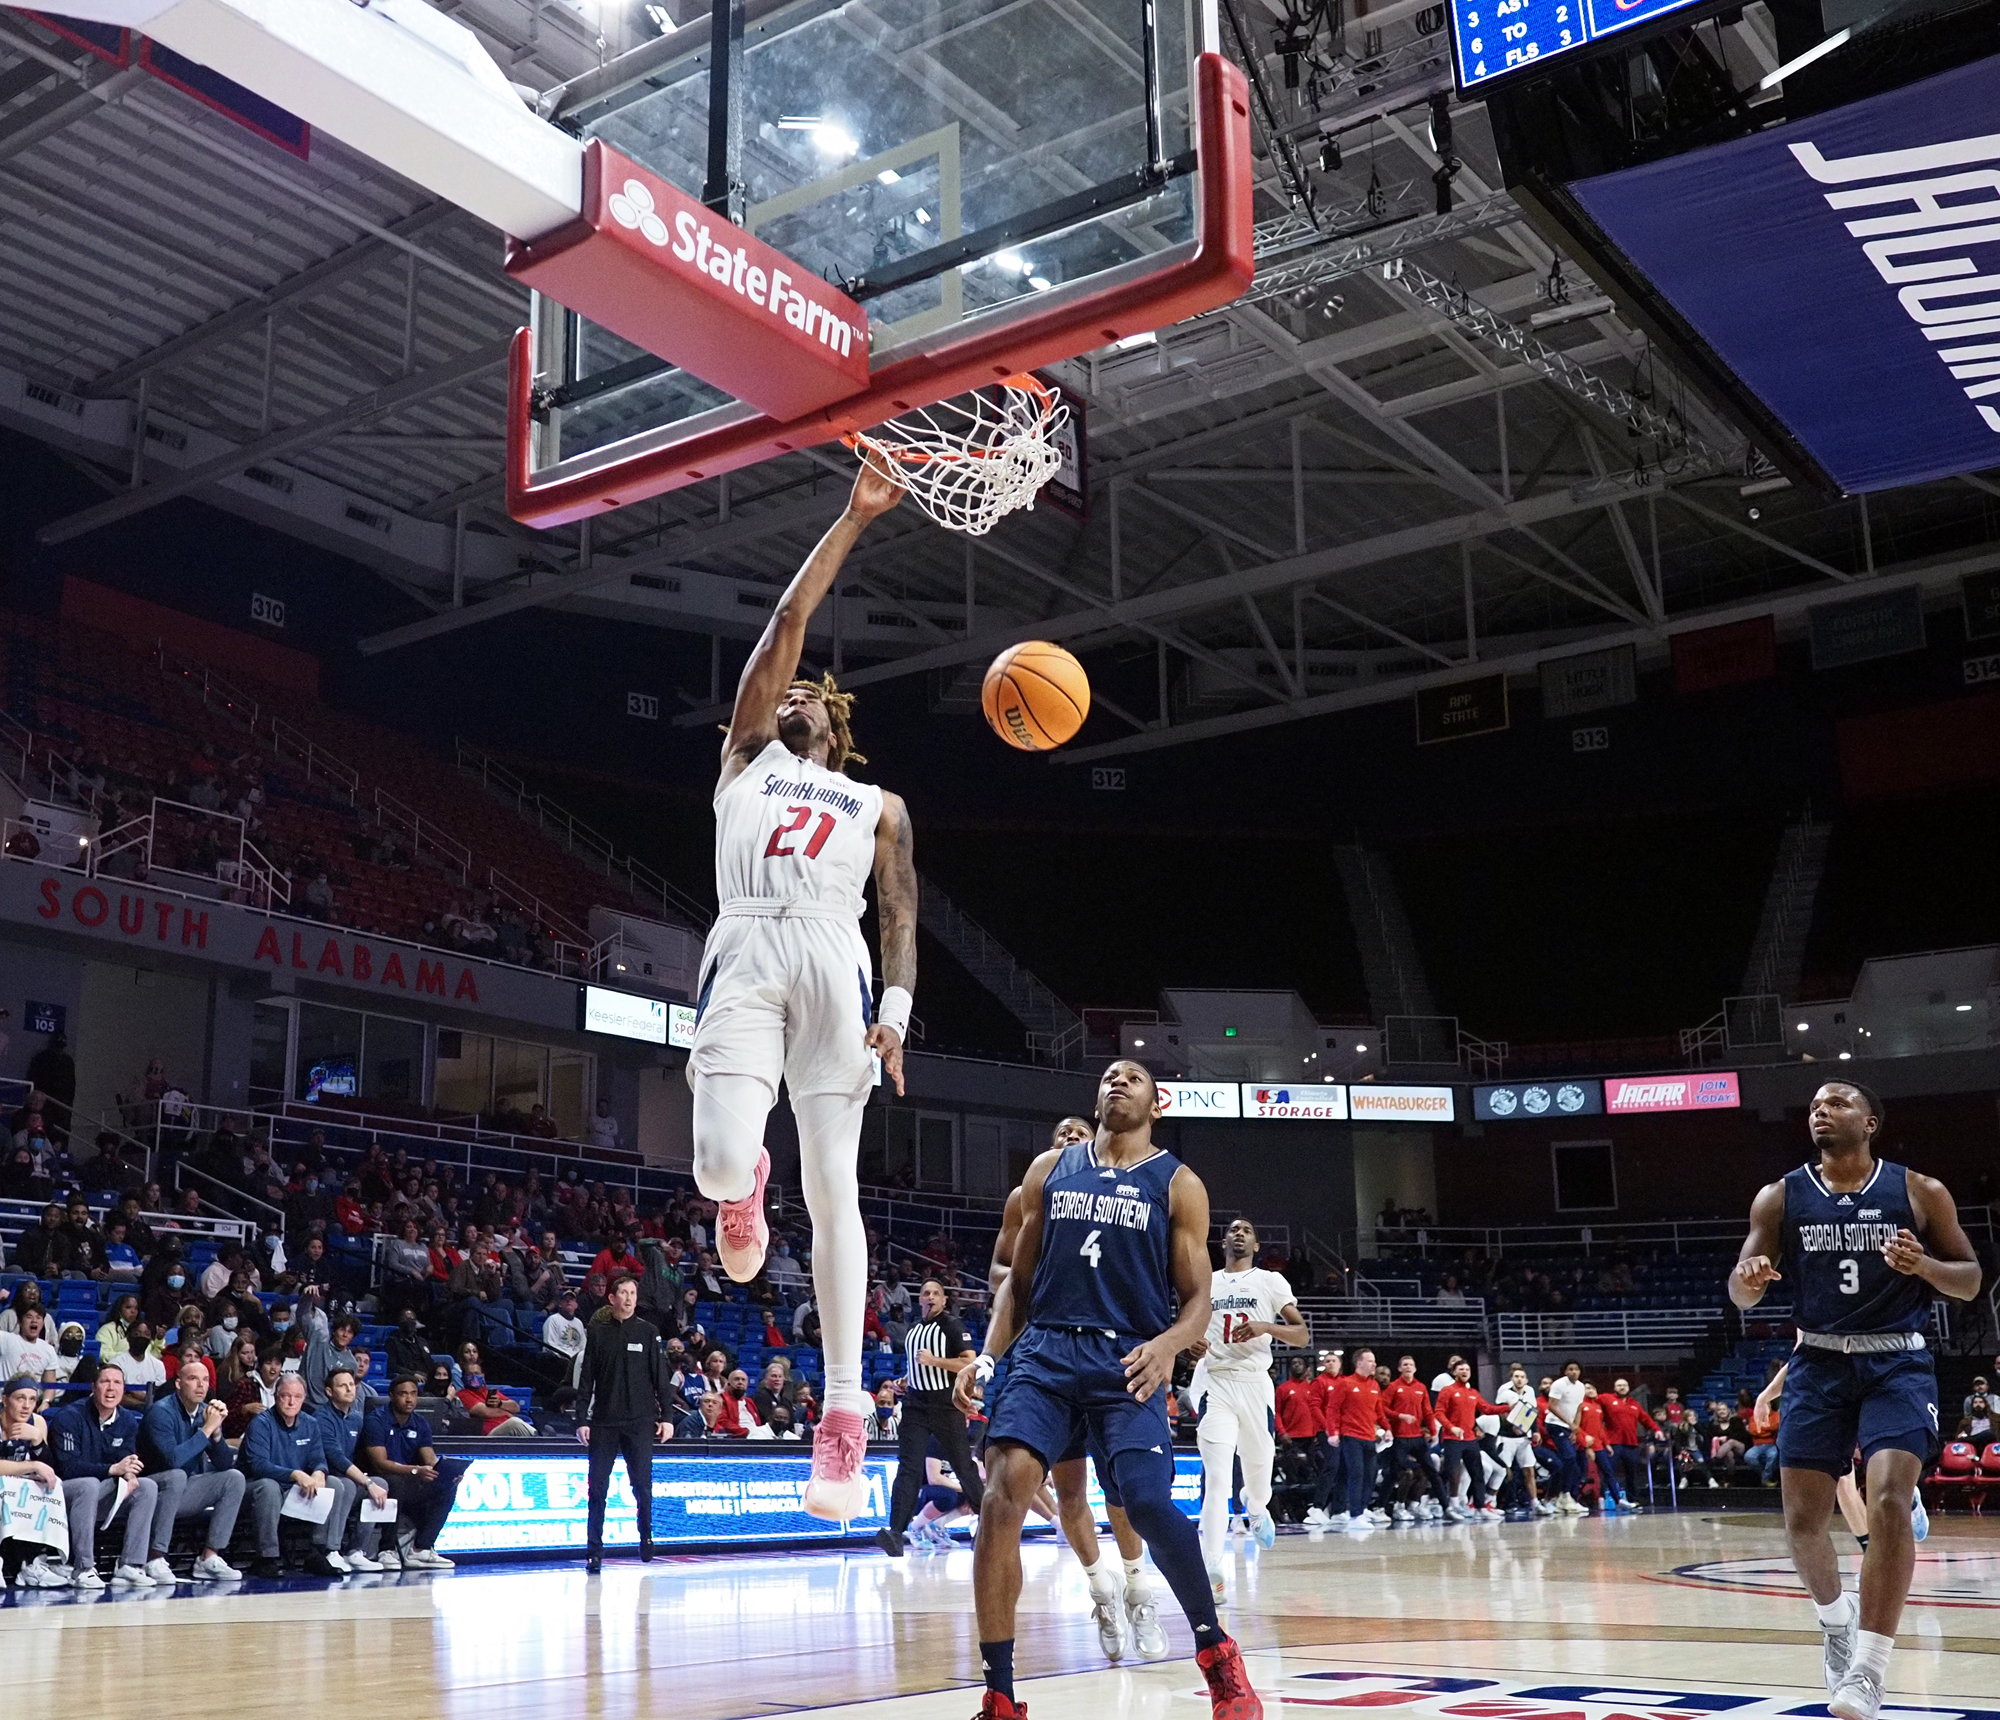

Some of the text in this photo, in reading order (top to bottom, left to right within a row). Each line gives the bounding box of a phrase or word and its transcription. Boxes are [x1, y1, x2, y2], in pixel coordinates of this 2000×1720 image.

[1468, 11, 1480, 28] 3
[1471, 5, 1569, 54] 6 TO 2
[1474, 29, 1572, 76] 4 FLS 3
[1057, 440, 1073, 461] 20
[253, 597, 283, 622] 310
[1966, 658, 2000, 680] 314
[629, 696, 656, 716] 311
[1449, 694, 1472, 708] APP
[1442, 707, 1480, 725] STATE
[1573, 730, 1607, 748] 313
[1094, 771, 1124, 787] 312
[763, 805, 837, 860] 21
[37, 878, 480, 1003] SOUTH ALABAMA
[35, 1019, 55, 1033] 105
[1256, 1089, 1290, 1104] USA
[1612, 1083, 1686, 1104] JAGUAR
[1699, 1081, 1727, 1093] JOIN
[1178, 1091, 1226, 1109] PNC
[1353, 1095, 1448, 1111] WHATABURGER
[1695, 1093, 1735, 1104] TODAY!
[1257, 1106, 1333, 1118] STORAGE
[1050, 1190, 1151, 1231] GEORGIA SOUTHERN
[1799, 1224, 1843, 1252] GEORGIA
[1080, 1229, 1102, 1268] 4
[1839, 1258, 1860, 1295] 3
[29, 1495, 62, 1506] POWERADE
